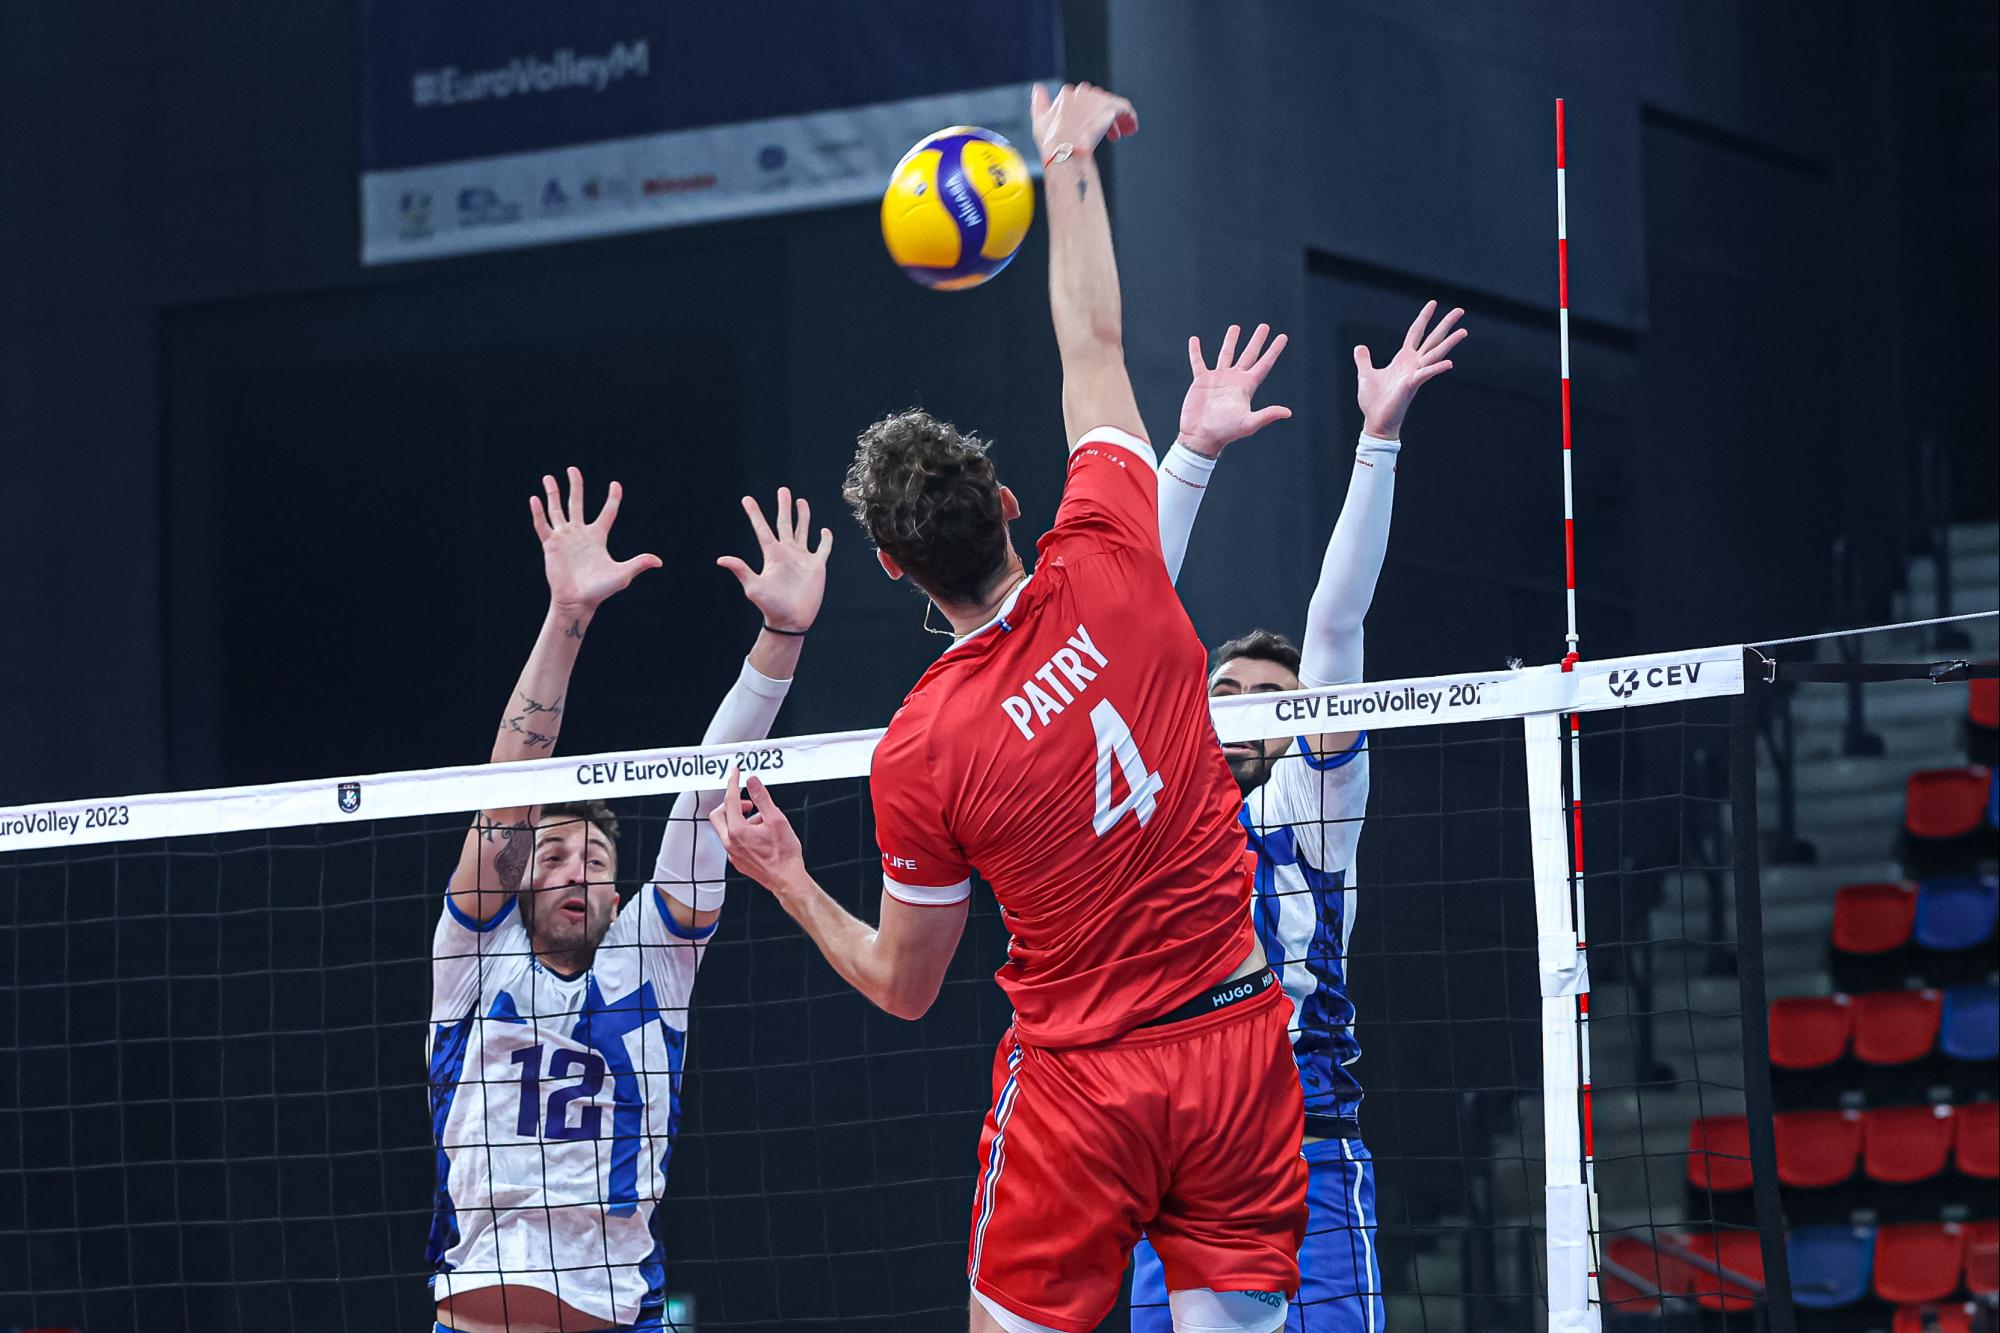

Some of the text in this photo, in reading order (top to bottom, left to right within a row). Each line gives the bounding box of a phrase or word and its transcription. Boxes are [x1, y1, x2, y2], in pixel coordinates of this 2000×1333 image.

[1001, 624, 1109, 741] PATRY
[1646, 662, 1701, 688] CEV
[1276, 681, 1499, 721] CEV EuroVolley 20
[577, 748, 784, 785] CEV EuroVolley 2023
[1089, 698, 1164, 837] 4
[85, 805, 129, 829] 2023
[1212, 983, 1253, 1007] HUGO
[510, 1044, 606, 1141] 12
